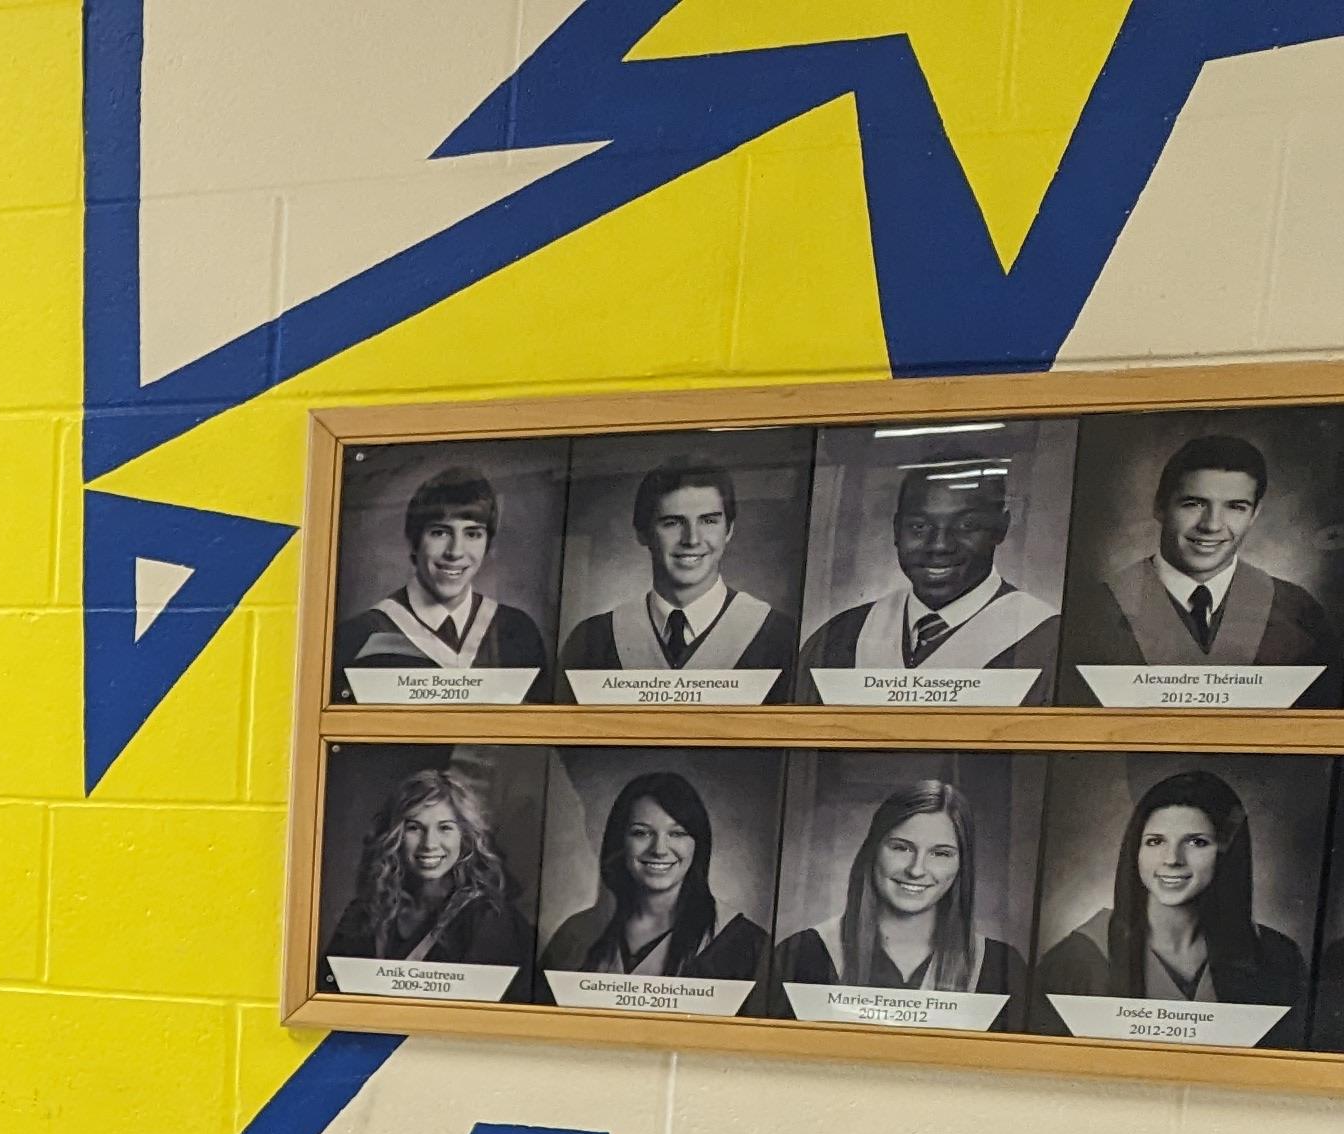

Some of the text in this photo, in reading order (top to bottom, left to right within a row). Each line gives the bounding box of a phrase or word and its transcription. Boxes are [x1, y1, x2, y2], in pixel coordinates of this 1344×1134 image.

[397, 675, 484, 687] Marc Boucher
[601, 676, 740, 689] Alexandre Arseneau
[863, 675, 981, 692] David Kassegne
[1132, 673, 1264, 686] Alexandre Thériault
[408, 688, 470, 700] 2009-2010
[637, 690, 703, 703] 2010-2011
[886, 690, 959, 703] 2011-2012
[1160, 692, 1230, 704] 2012-2013
[375, 965, 465, 981] Anik Gautreau
[390, 978, 452, 993] 2009-2010
[578, 979, 715, 998] Gabrielle Robichaud
[614, 993, 679, 1009] 2010-2011
[827, 991, 959, 1011] Marie-France Finn
[858, 1007, 929, 1023] 2011-2012
[1115, 1005, 1215, 1024] Josée Bourque
[1128, 1023, 1197, 1038] 2012-2013
